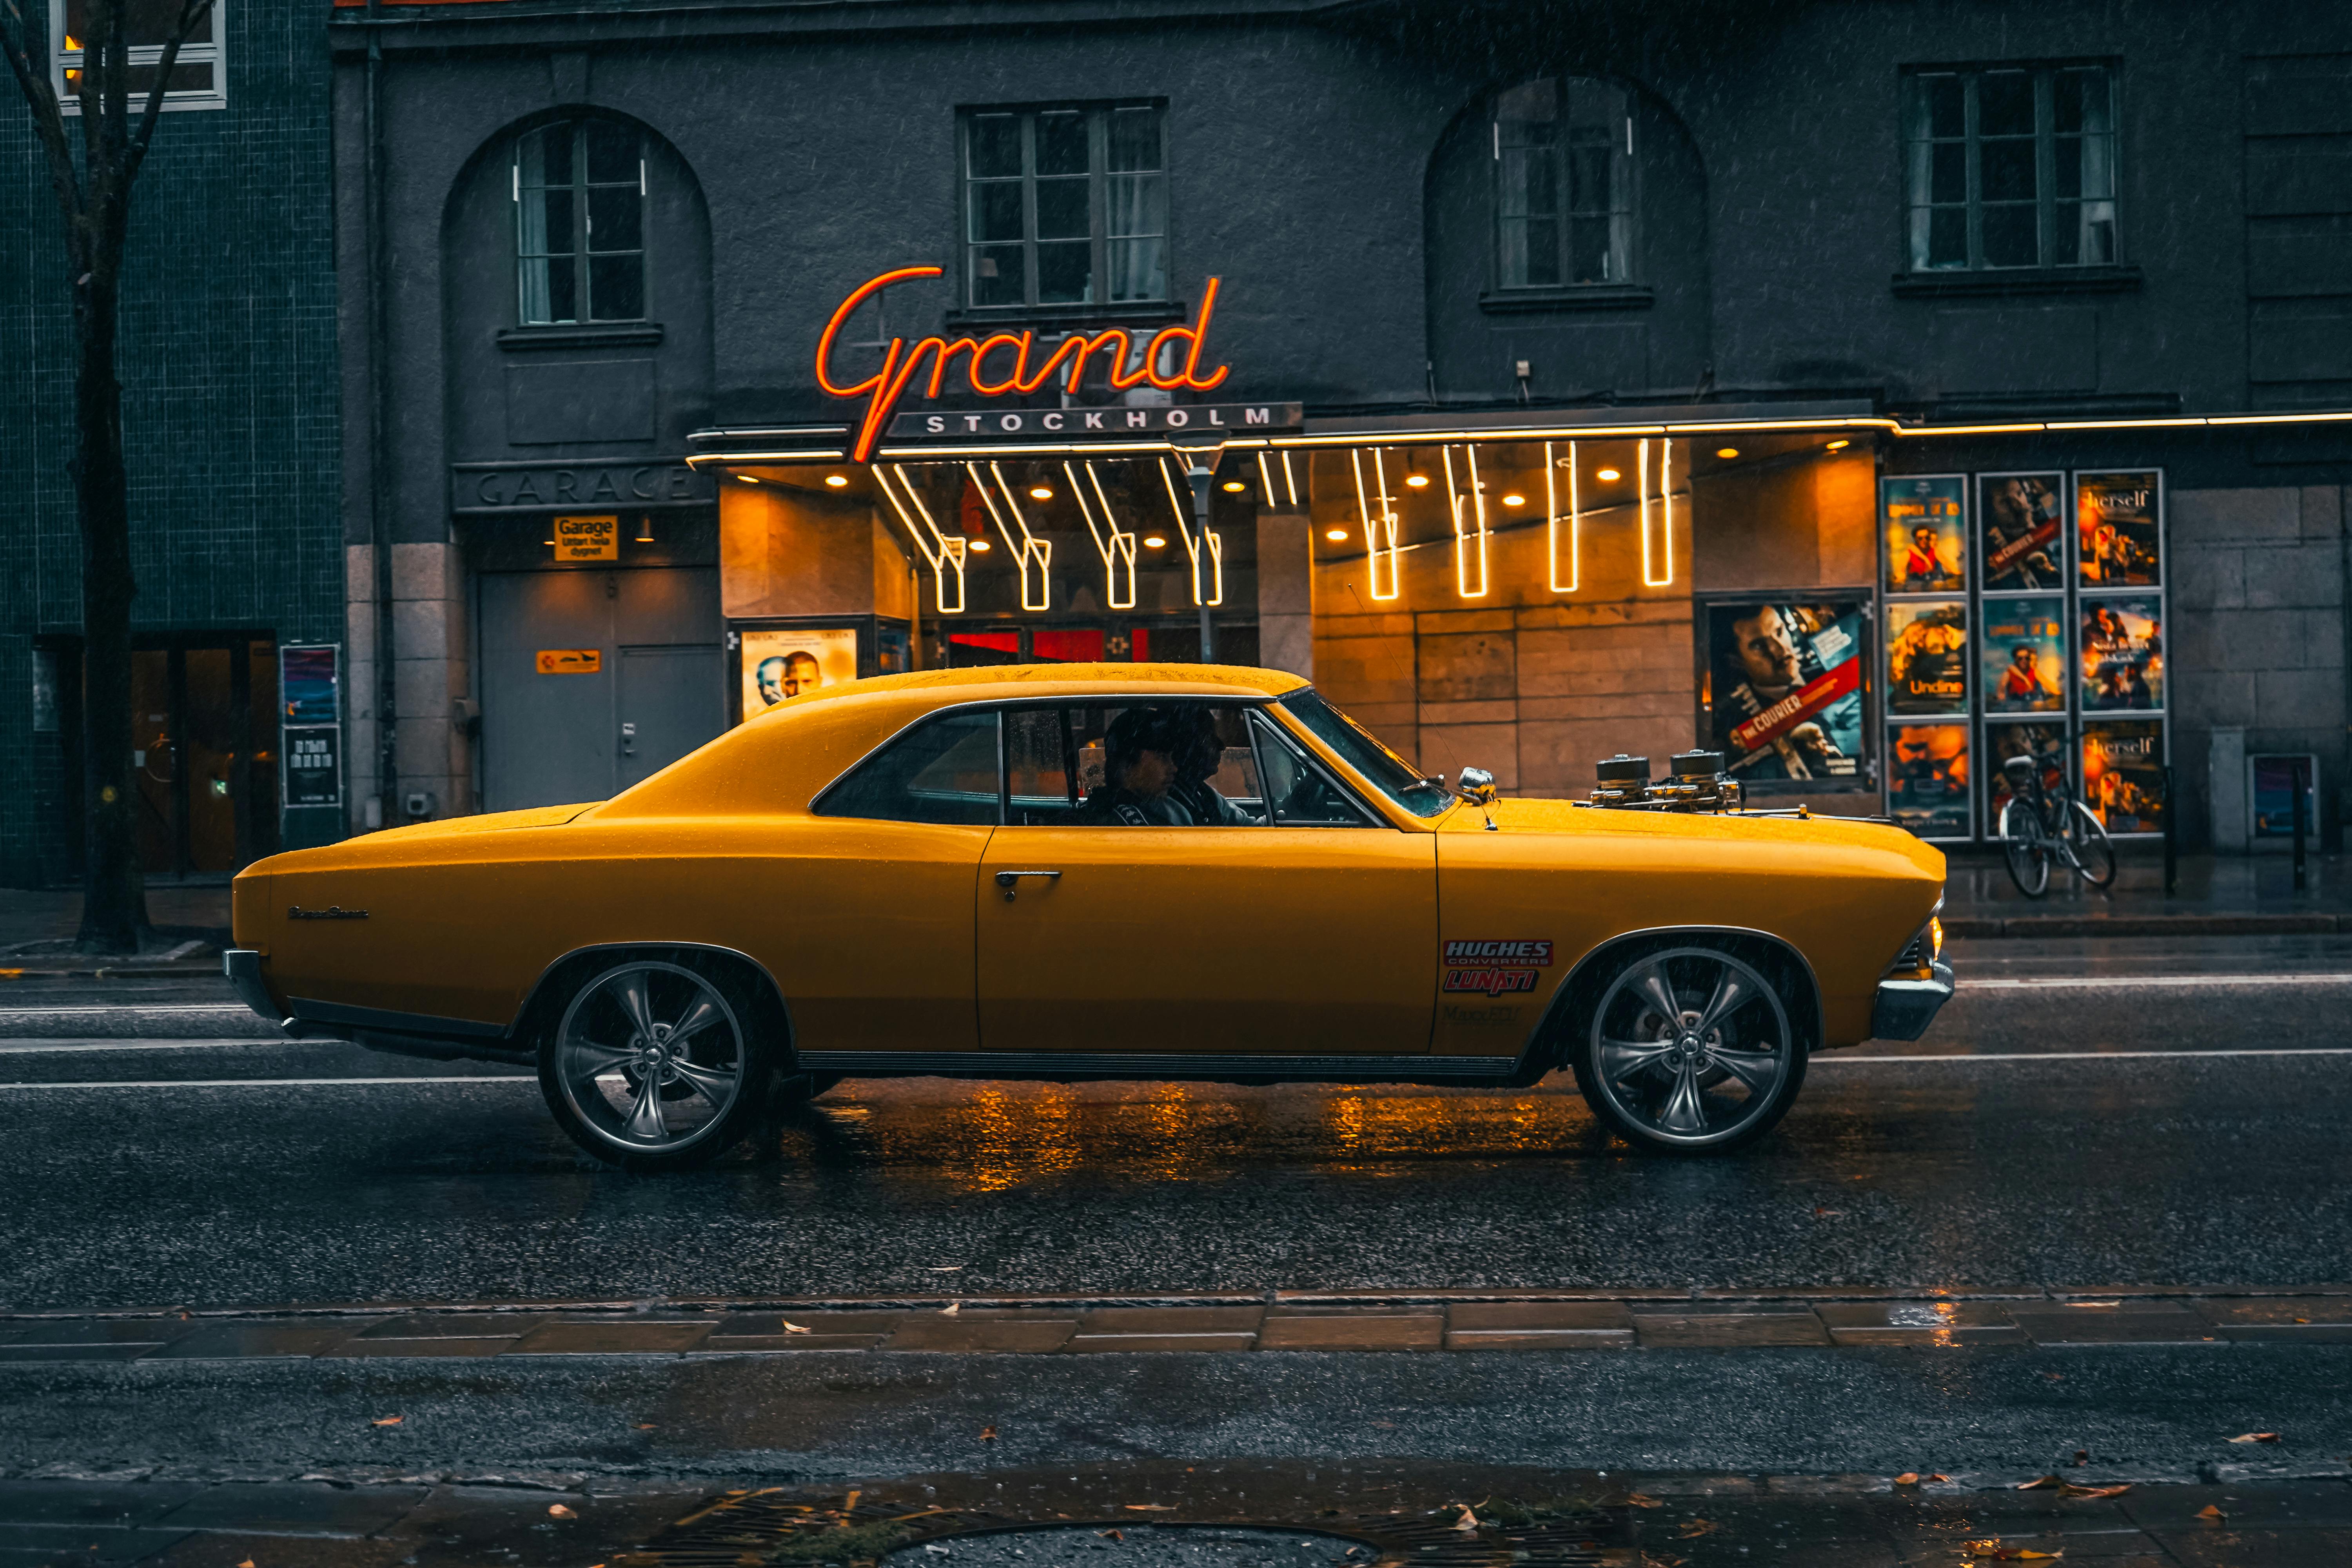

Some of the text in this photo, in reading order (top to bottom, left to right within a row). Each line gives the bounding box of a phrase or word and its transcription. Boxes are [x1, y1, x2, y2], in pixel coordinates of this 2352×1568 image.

[815, 266, 1230, 462] Grand
[926, 407, 1270, 433] STOCKHOLM
[477, 467, 697, 505] GARAGE
[2087, 490, 2149, 508] herself
[559, 519, 613, 537] Garage
[1753, 694, 1803, 732] COURIER
[1446, 942, 1550, 956] HUGHES
[1444, 967, 1536, 995] LUNATI
